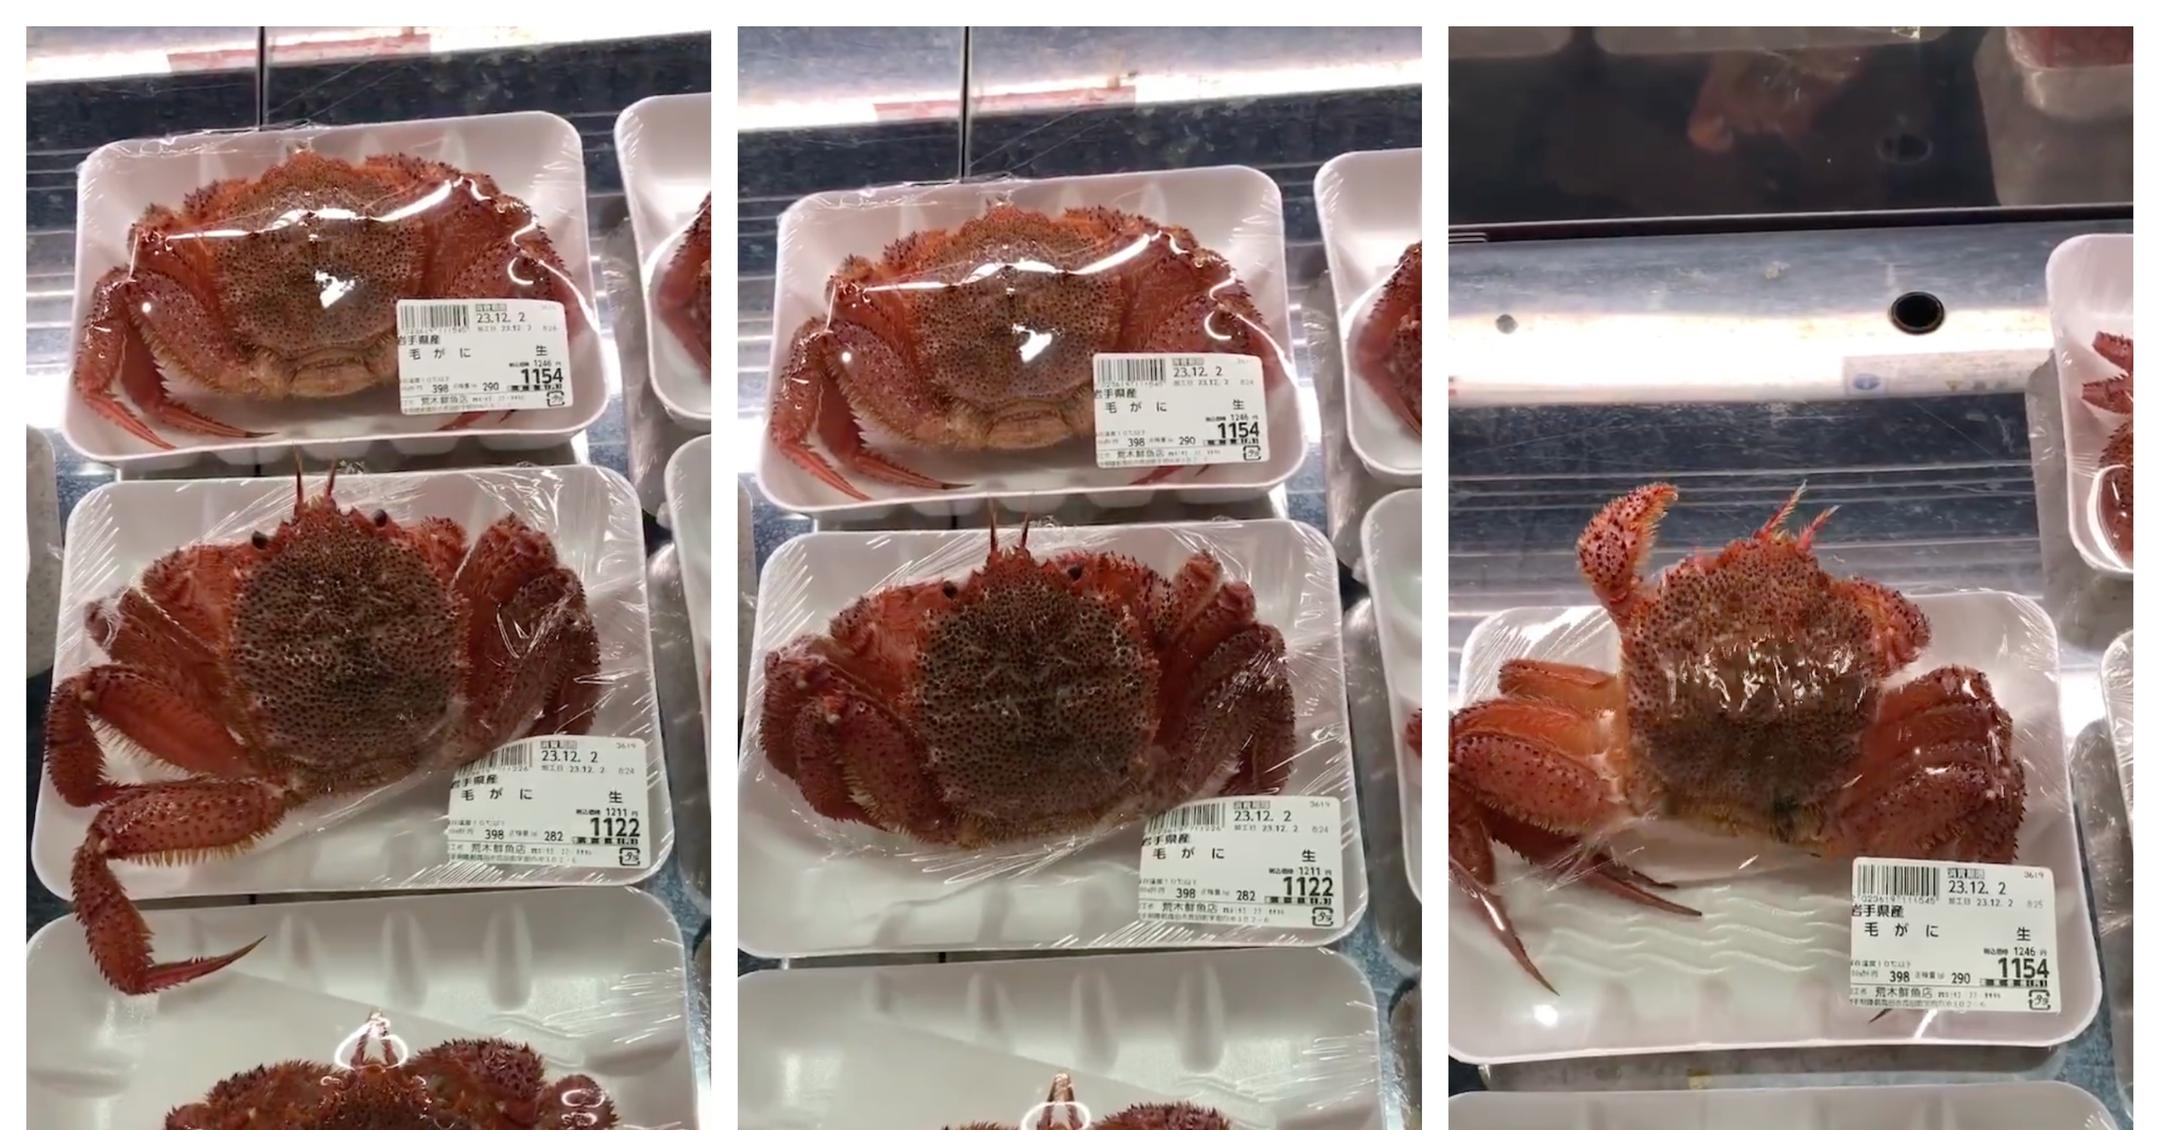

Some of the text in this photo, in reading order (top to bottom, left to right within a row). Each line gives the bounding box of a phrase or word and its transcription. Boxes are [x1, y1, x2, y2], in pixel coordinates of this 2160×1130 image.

[536, 346, 547, 357] 生
[521, 368, 564, 384] 1154
[432, 384, 449, 394] 398
[482, 382, 500, 392] 290
[1233, 400, 1245, 411] 生
[1217, 422, 1260, 439] 1154
[1128, 438, 1145, 448] 398
[1179, 436, 1196, 446] 290
[542, 751, 582, 763] 23.12.
[608, 791, 623, 804] 生
[606, 808, 627, 817] 1211
[1234, 810, 1274, 822] 23.12.
[590, 818, 640, 837] 1122
[485, 830, 505, 840] 398
[544, 831, 564, 842] 282
[1302, 850, 1316, 863] 生
[1298, 867, 1321, 876] 1211
[1283, 877, 1334, 897] 1122
[1948, 880, 2006, 895] 23.12. 2
[1176, 888, 1197, 899] 398
[1236, 890, 1256, 901] 282
[1851, 904, 1904, 918] 岩手県産
[2016, 926, 2031, 942] 生
[2014, 947, 2036, 957] 1246
[1998, 957, 2050, 979] 1154
[1890, 970, 1910, 983] 398
[1952, 972, 1971, 984] 290
